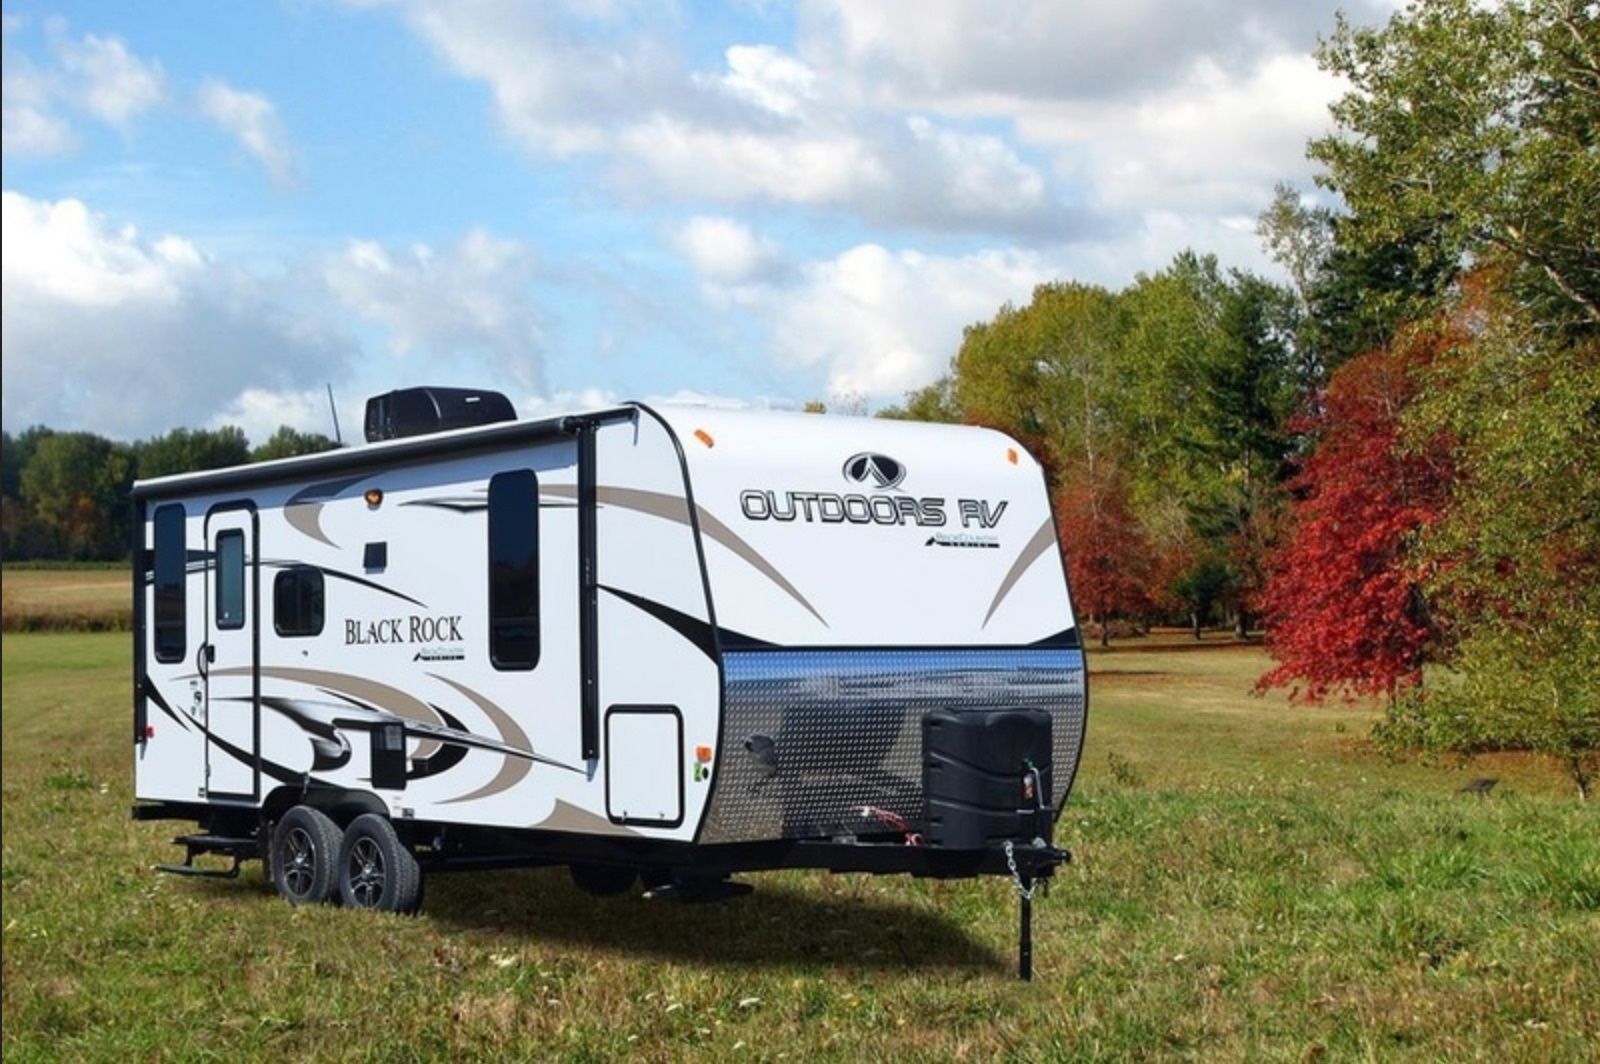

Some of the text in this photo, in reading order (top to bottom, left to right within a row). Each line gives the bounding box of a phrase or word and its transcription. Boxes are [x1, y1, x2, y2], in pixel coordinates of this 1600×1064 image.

[739, 489, 1009, 528] OUTDOORS RV
[344, 615, 464, 645] BLACK ROCK
